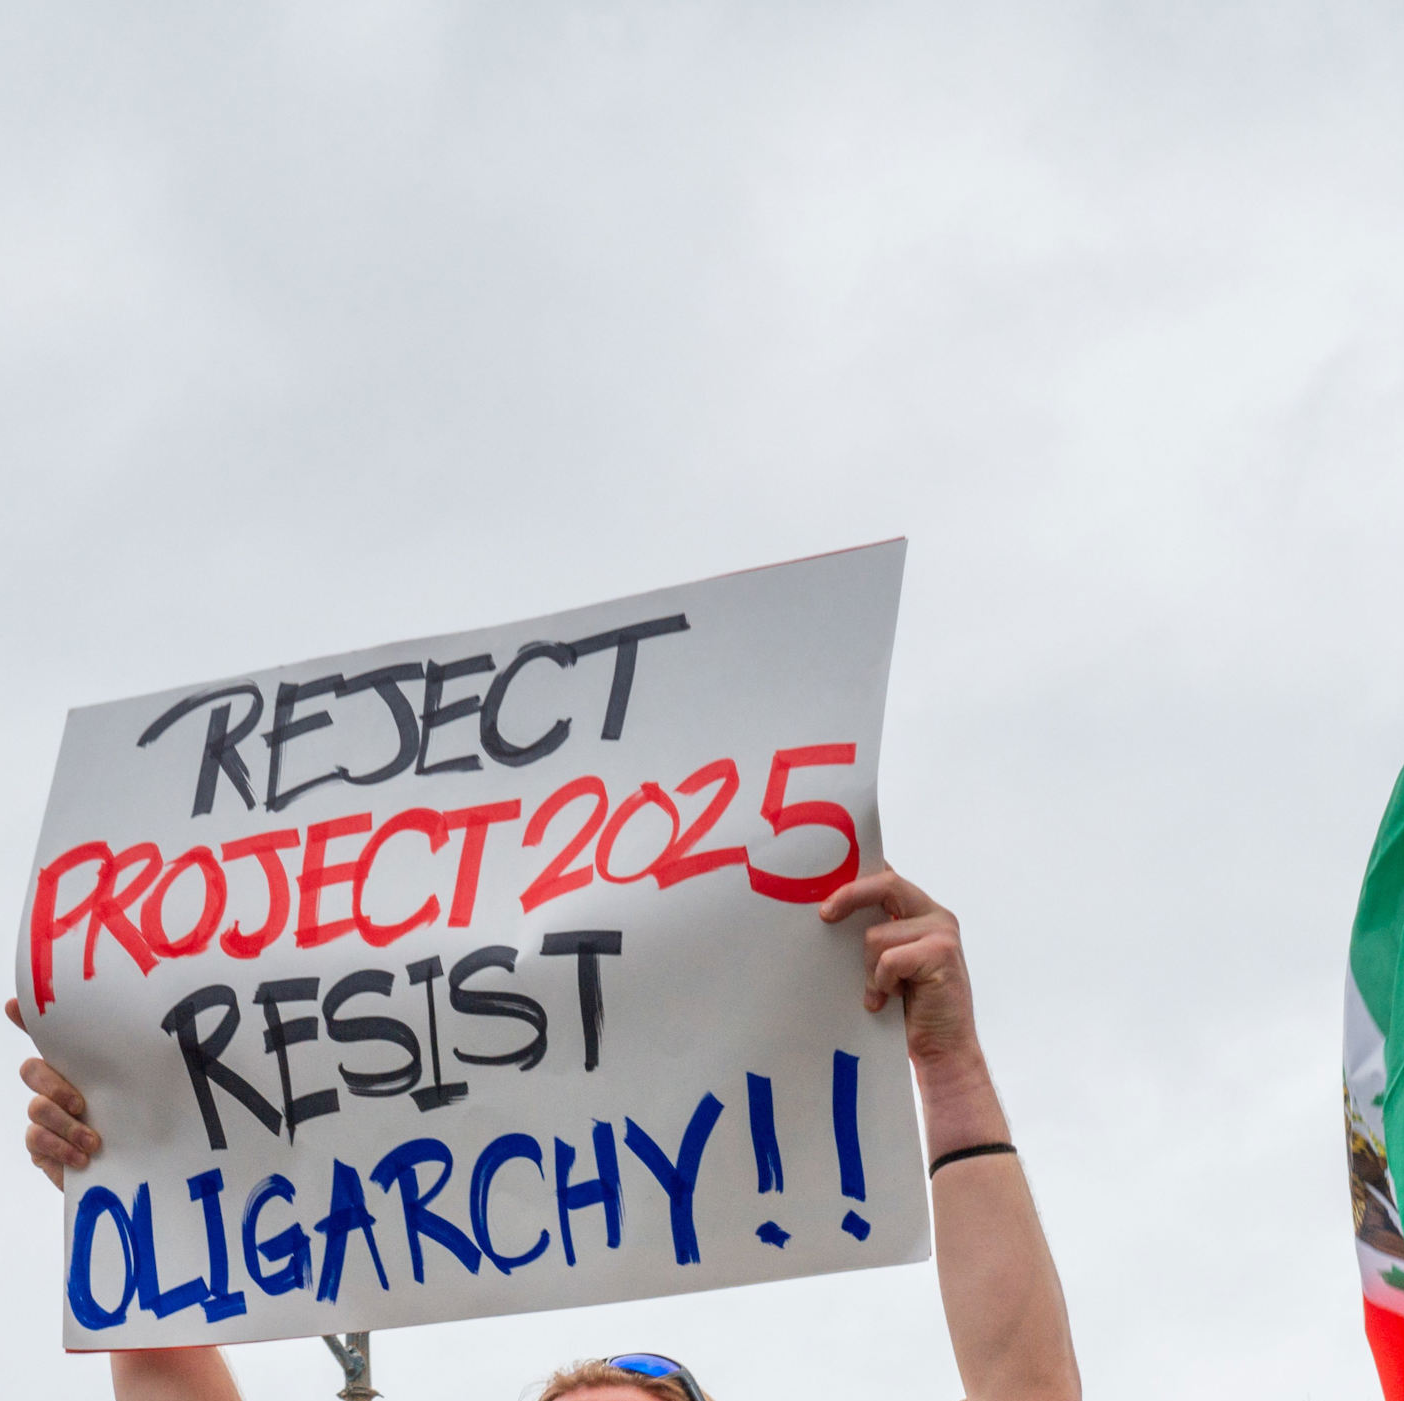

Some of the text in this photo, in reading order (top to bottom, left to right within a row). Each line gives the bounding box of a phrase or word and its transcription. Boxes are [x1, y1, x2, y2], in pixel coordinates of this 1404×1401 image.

[137, 613, 691, 817] REJECT
[31, 743, 860, 1015] PROJECT 2025
[161, 930, 623, 1152] RESIST
